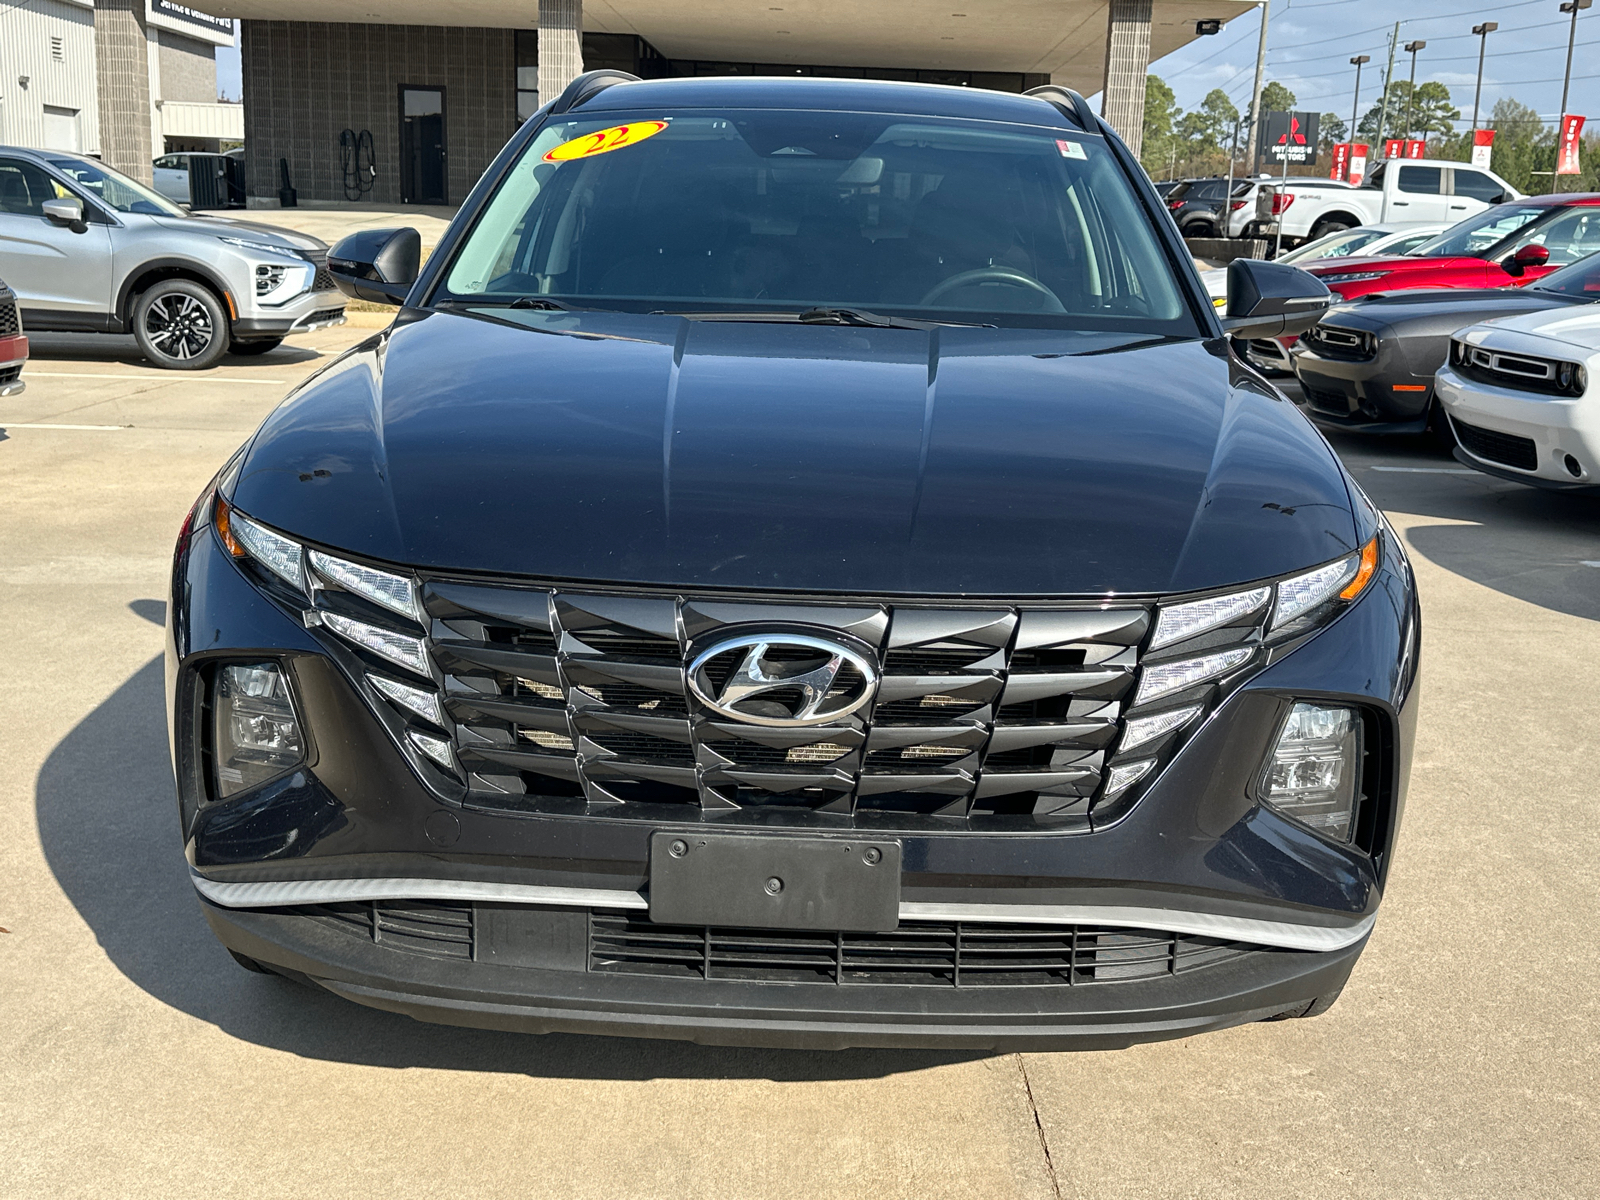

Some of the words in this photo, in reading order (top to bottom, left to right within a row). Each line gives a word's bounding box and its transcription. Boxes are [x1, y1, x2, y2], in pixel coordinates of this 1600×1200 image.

[583, 126, 629, 155] 22
[1567, 119, 1578, 141] NEW
[1271, 145, 1313, 154] MITUBISHI
